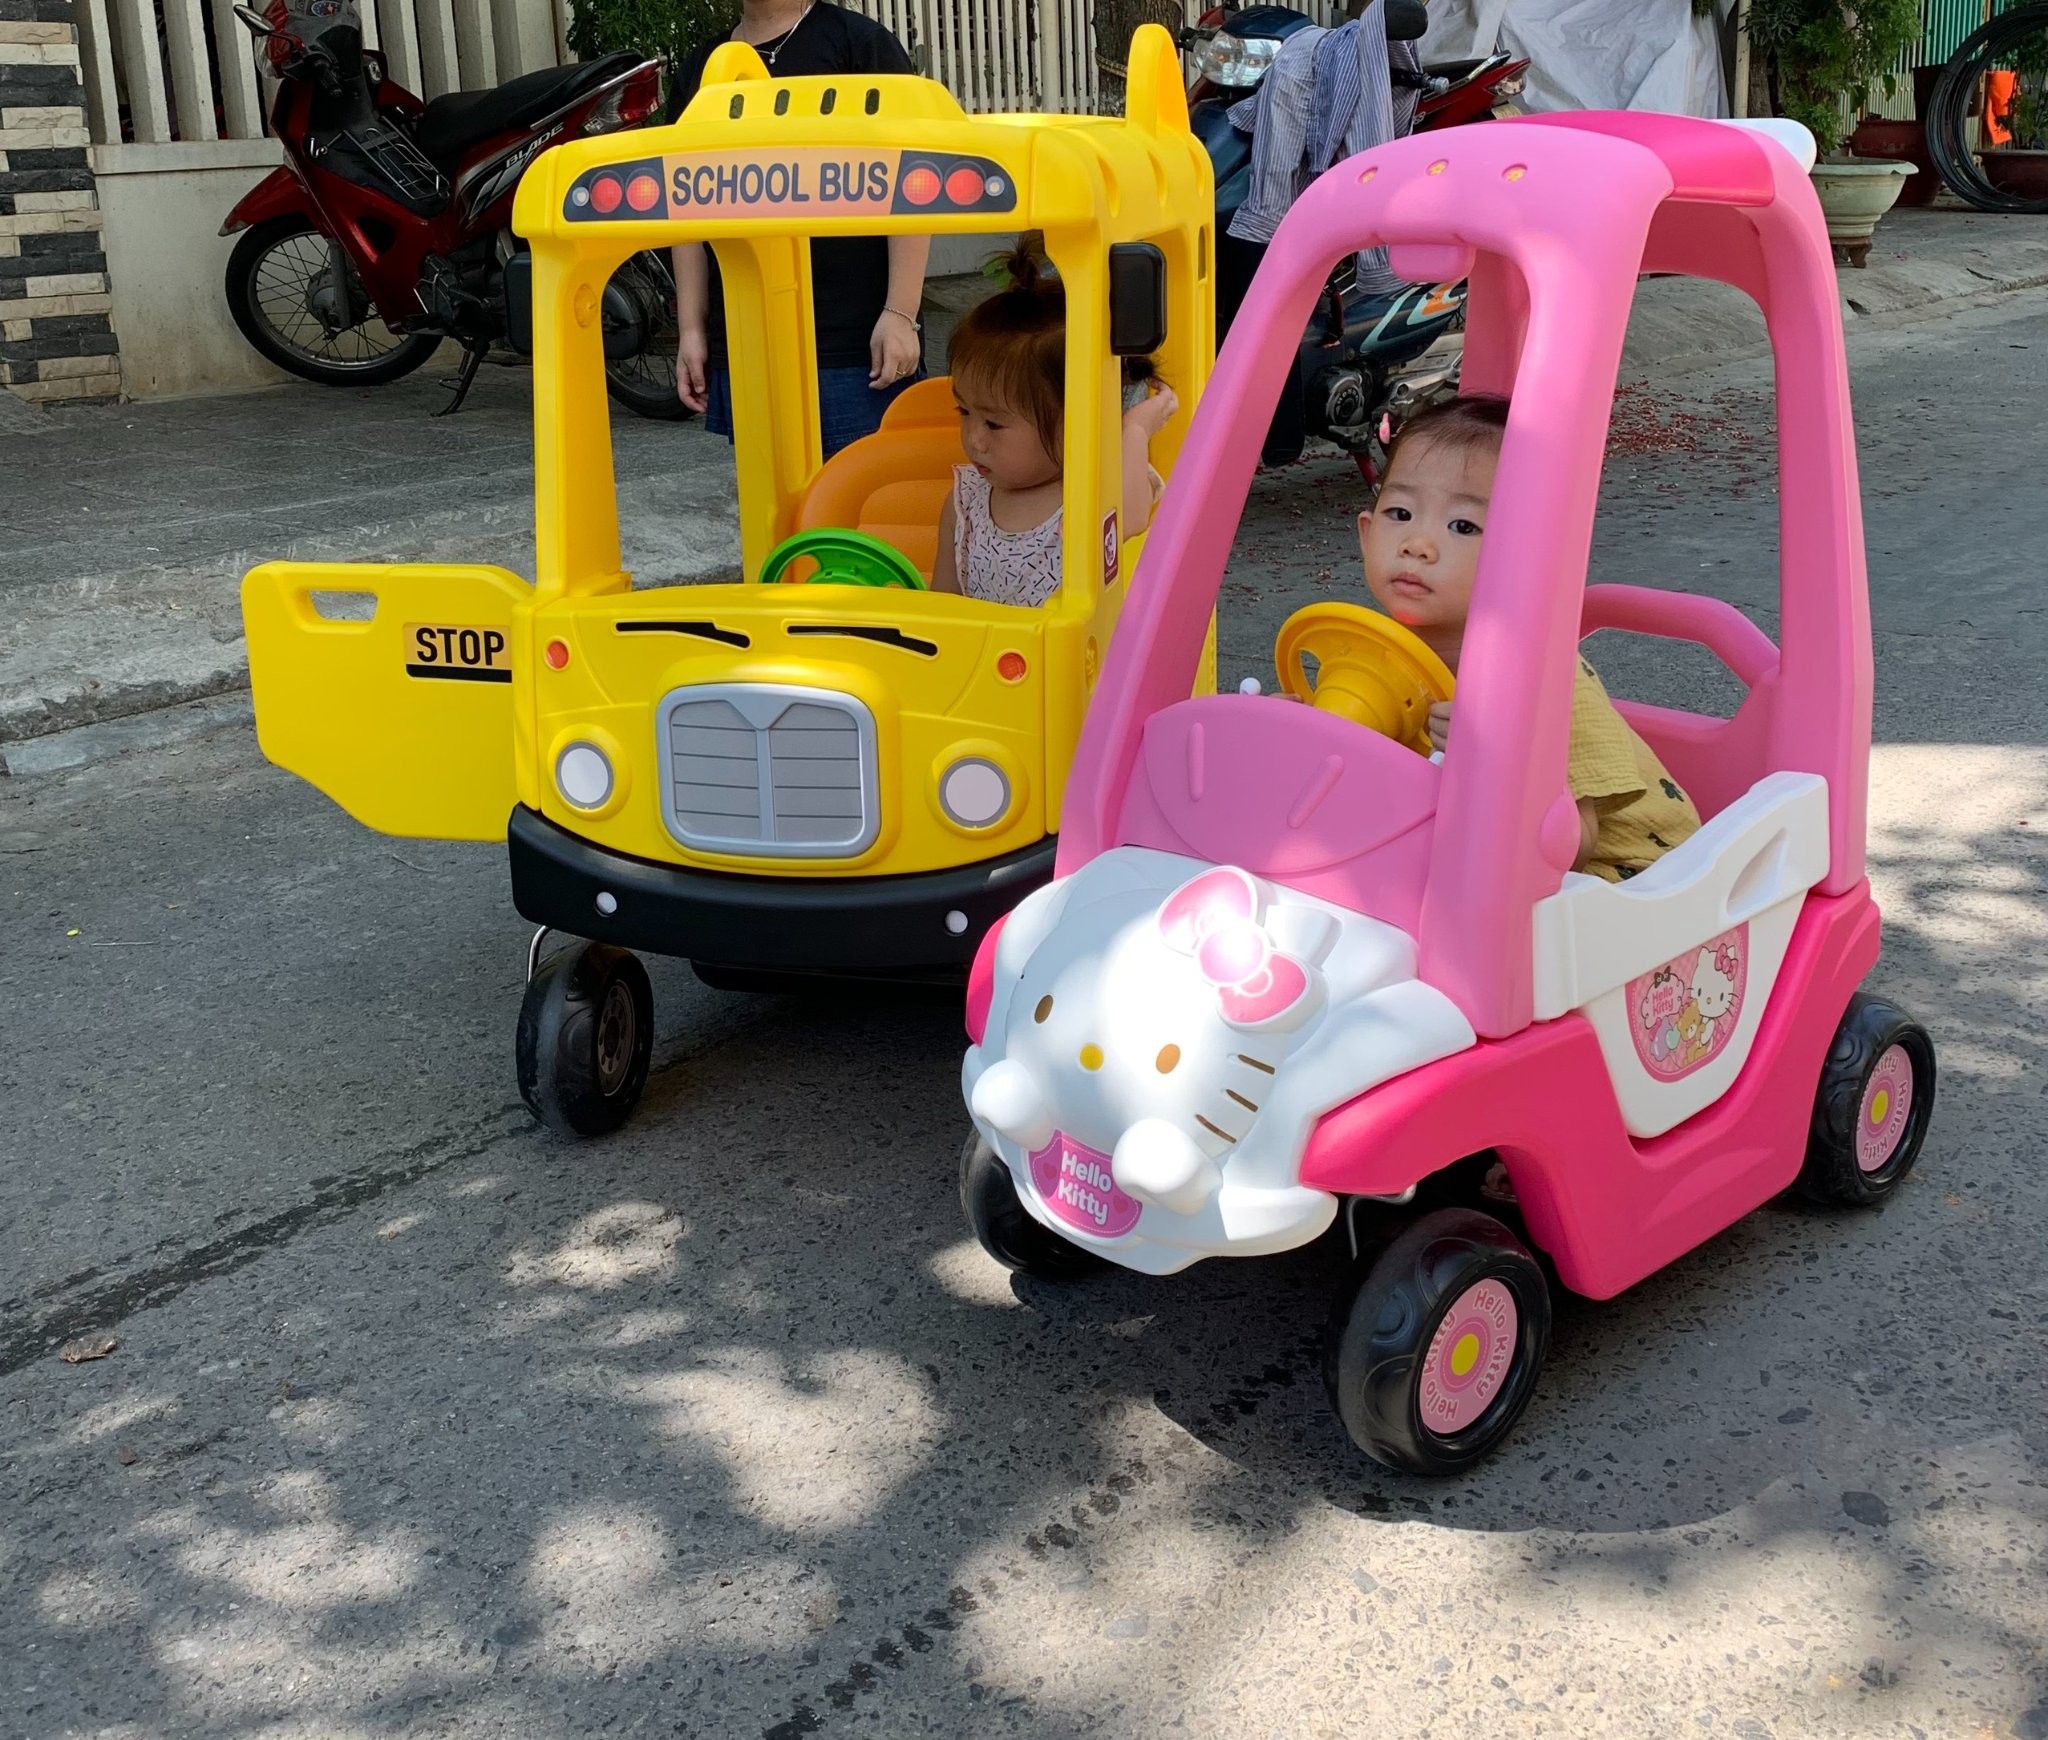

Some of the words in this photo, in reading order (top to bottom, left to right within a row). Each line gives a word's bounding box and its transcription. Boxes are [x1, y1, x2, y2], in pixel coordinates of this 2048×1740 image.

[505, 121, 565, 168] BLADE
[671, 162, 811, 207] SCHOOL
[818, 160, 889, 202] BUS
[415, 627, 505, 666] STOP
[1652, 985, 1674, 1003] Hello
[1652, 997, 1674, 1017] Kitty
[1889, 1081, 1908, 1134] Hello
[1863, 1137, 1888, 1161] Kitty
[1061, 1150, 1113, 1193] Hello
[1057, 1178, 1109, 1225] Kitty
[1473, 1289, 1507, 1330] Hello
[1422, 1310, 1456, 1375] Kitty
[1475, 1335, 1508, 1397] Kitty
[1425, 1380, 1458, 1420] Hello
